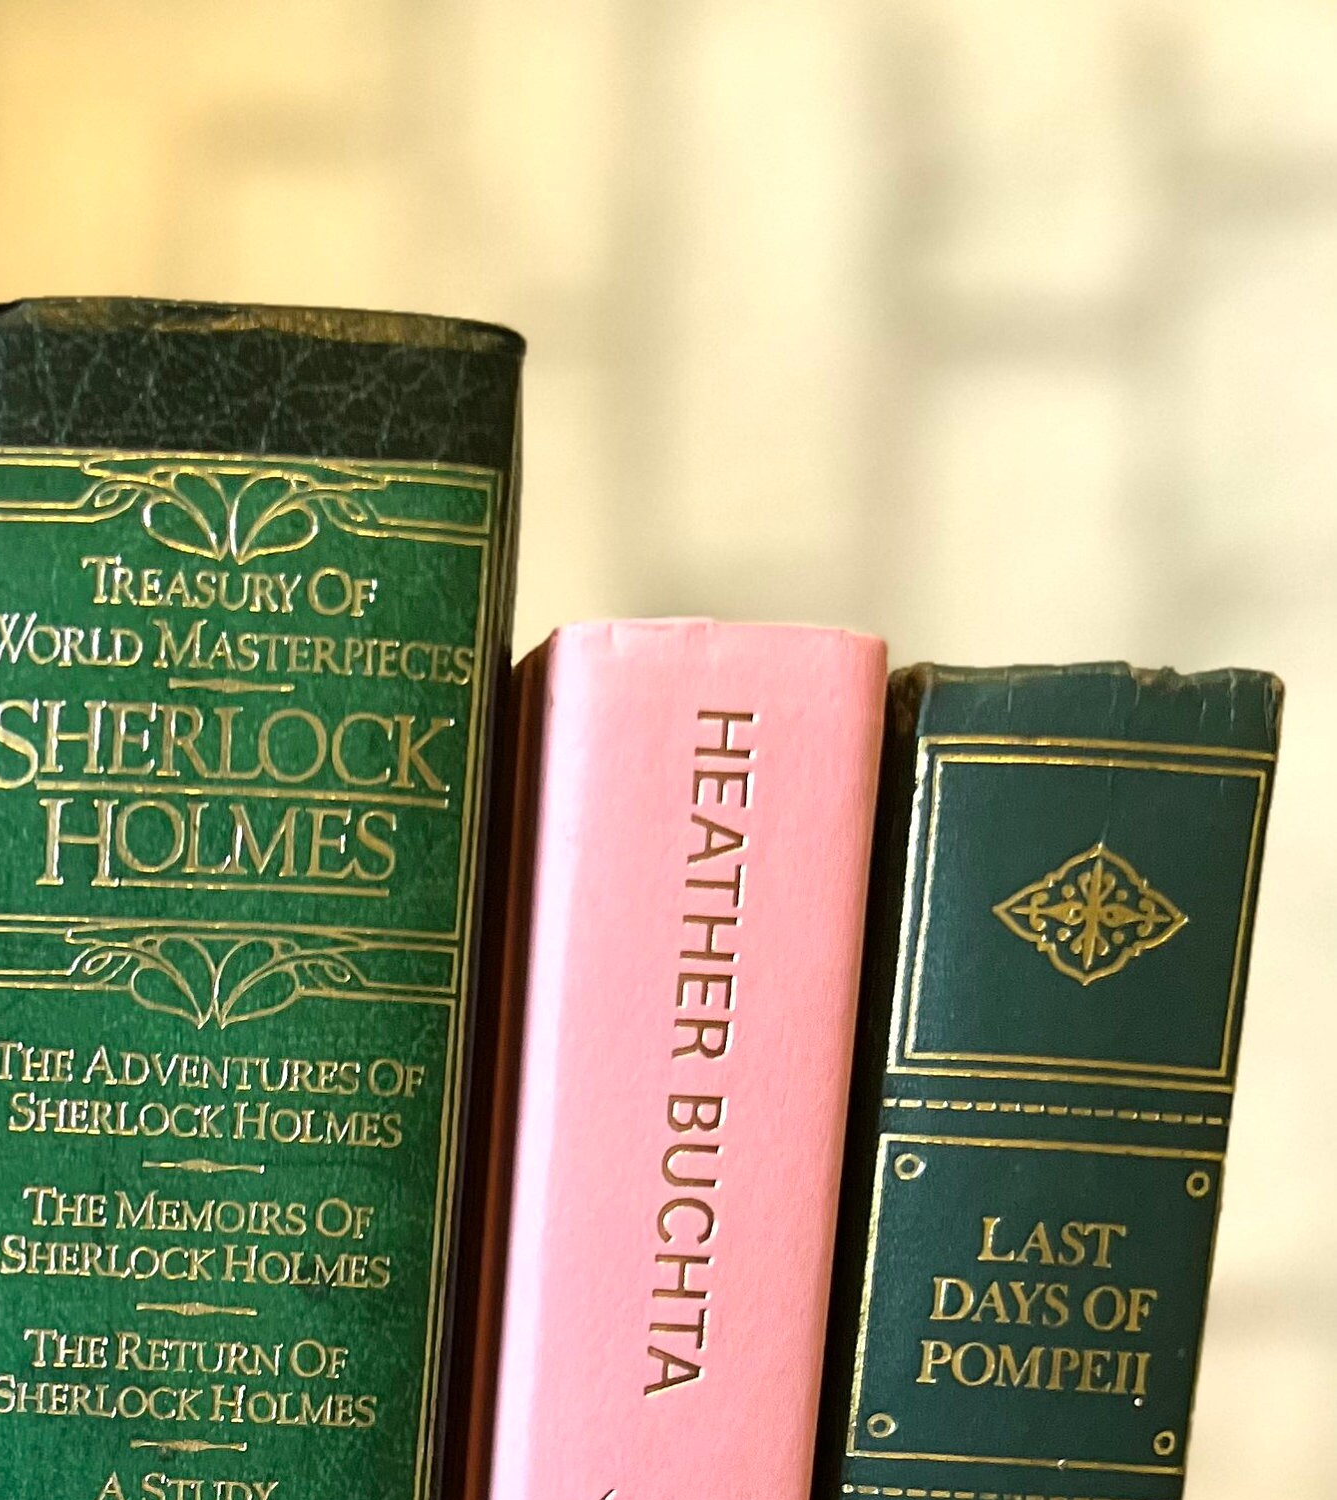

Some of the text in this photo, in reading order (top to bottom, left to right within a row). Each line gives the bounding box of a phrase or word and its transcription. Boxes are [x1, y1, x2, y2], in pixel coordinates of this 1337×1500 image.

[82, 553, 379, 618] TREASURY OF
[152, 617, 475, 686] MASTERPIECES
[35, 797, 399, 888] HOLMES
[82, 1045, 361, 1096] ADVENTURES
[367, 1059, 426, 1099] OF
[644, 709, 759, 1398] HEATHER BUCHTA
[8, 1092, 403, 1149] SHERLOCK HOLMES
[22, 1186, 375, 1240] THE MEMOIRS OF
[0, 1235, 391, 1289] SHERLOCK HOLMES
[977, 1216, 1127, 1269] LAST
[929, 1276, 1158, 1332] DAYS OF
[23, 1328, 349, 1380] THE RETURN OF
[915, 1340, 1152, 1396] POMPEII
[211, 1384, 378, 1428] HOLMES
